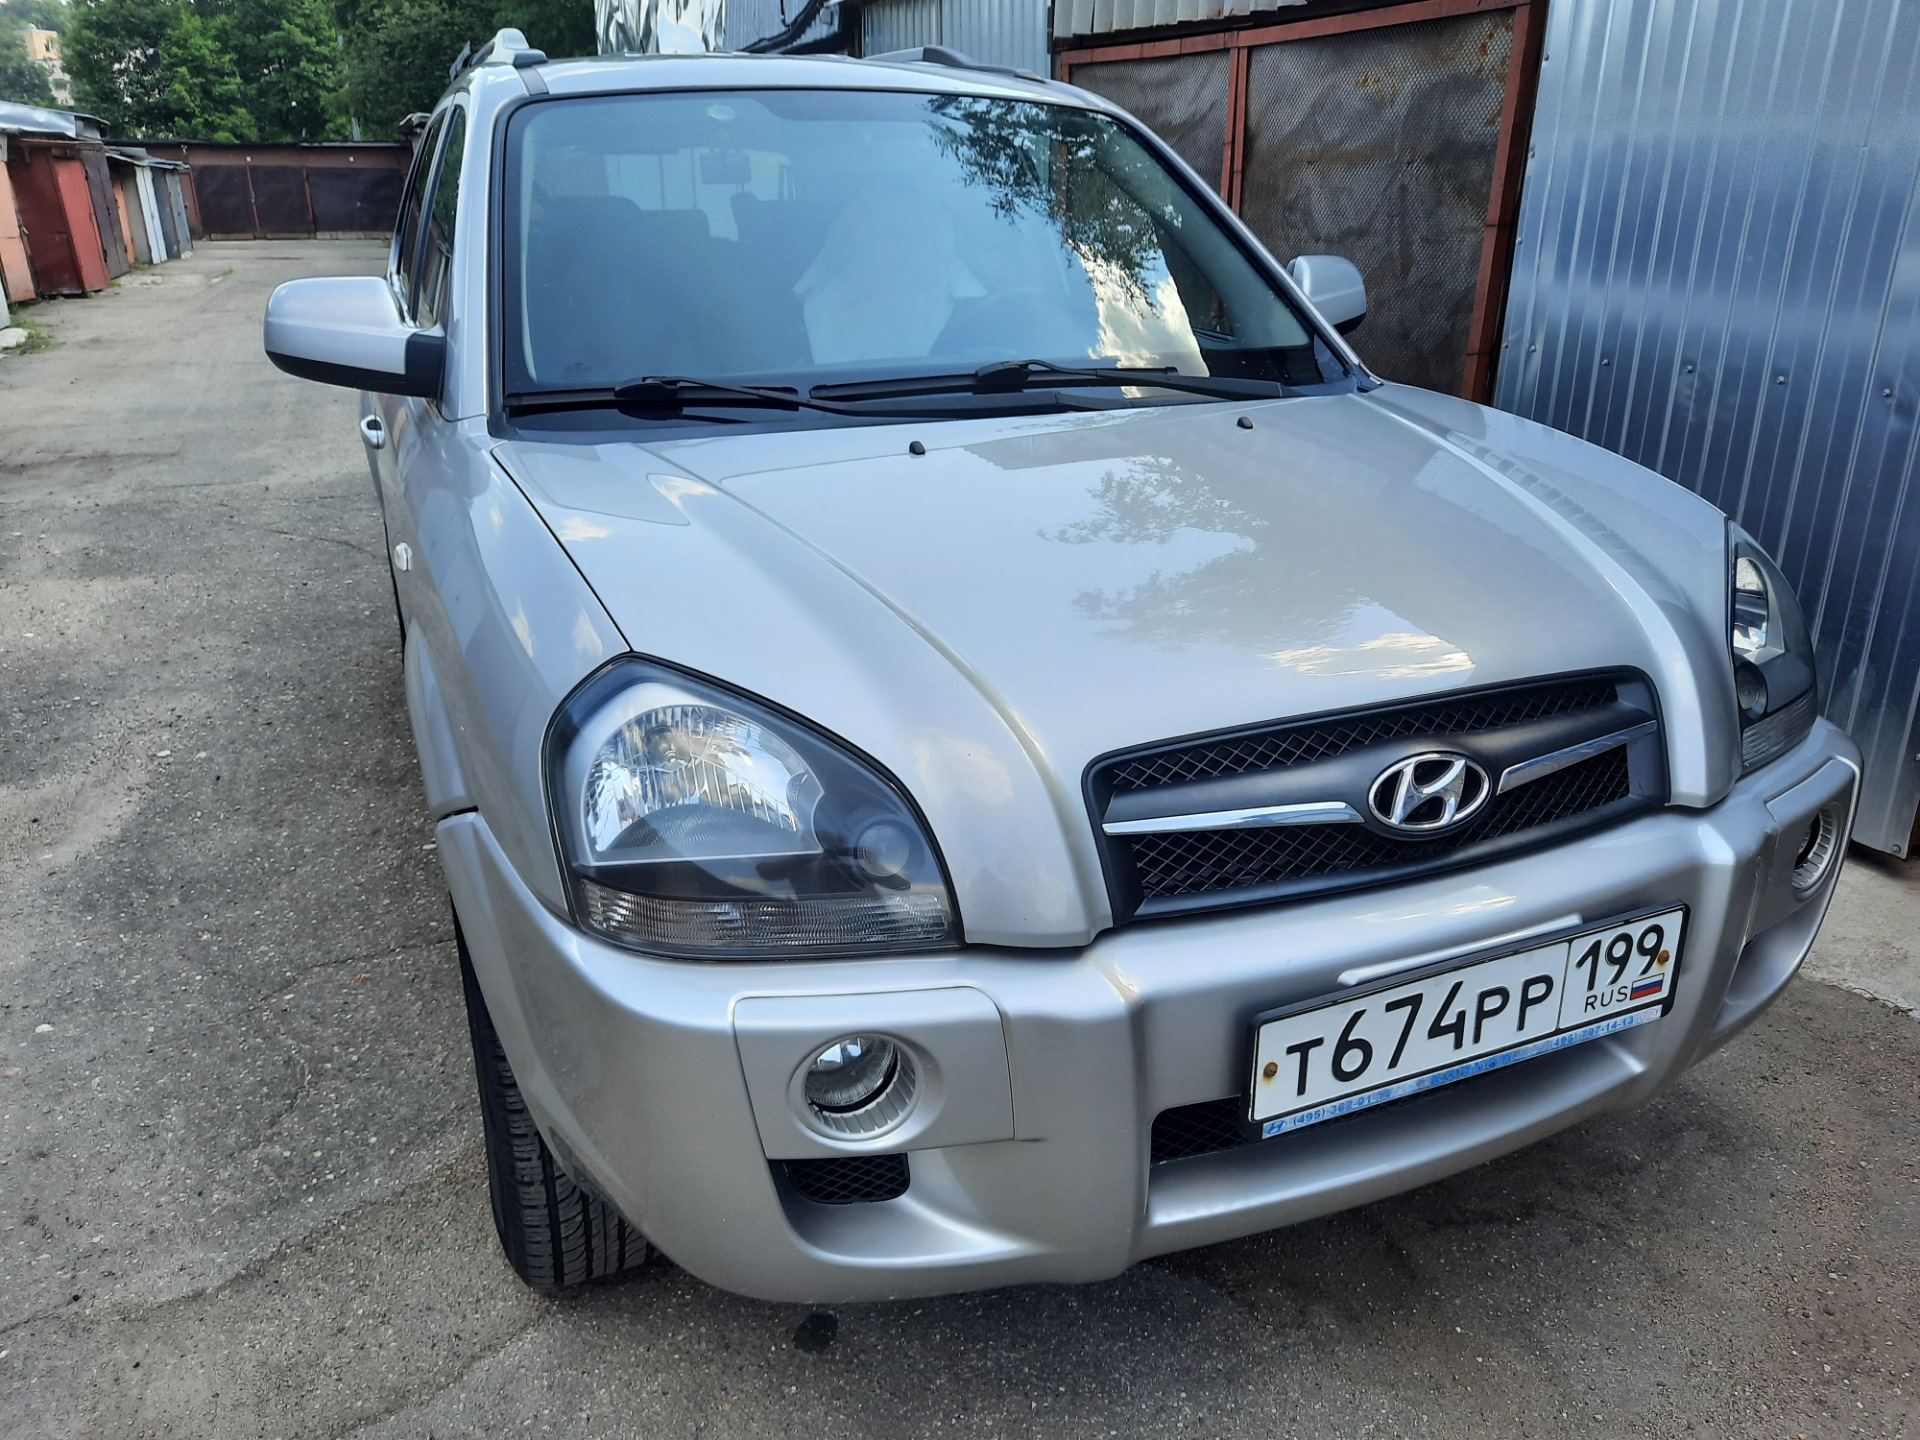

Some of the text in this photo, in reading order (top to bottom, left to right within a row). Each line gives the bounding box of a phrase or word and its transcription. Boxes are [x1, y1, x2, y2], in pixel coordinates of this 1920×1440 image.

[1575, 924, 1664, 992] 199
[1584, 986, 1628, 1013] RUS
[1293, 1108, 1326, 1126] (495)
